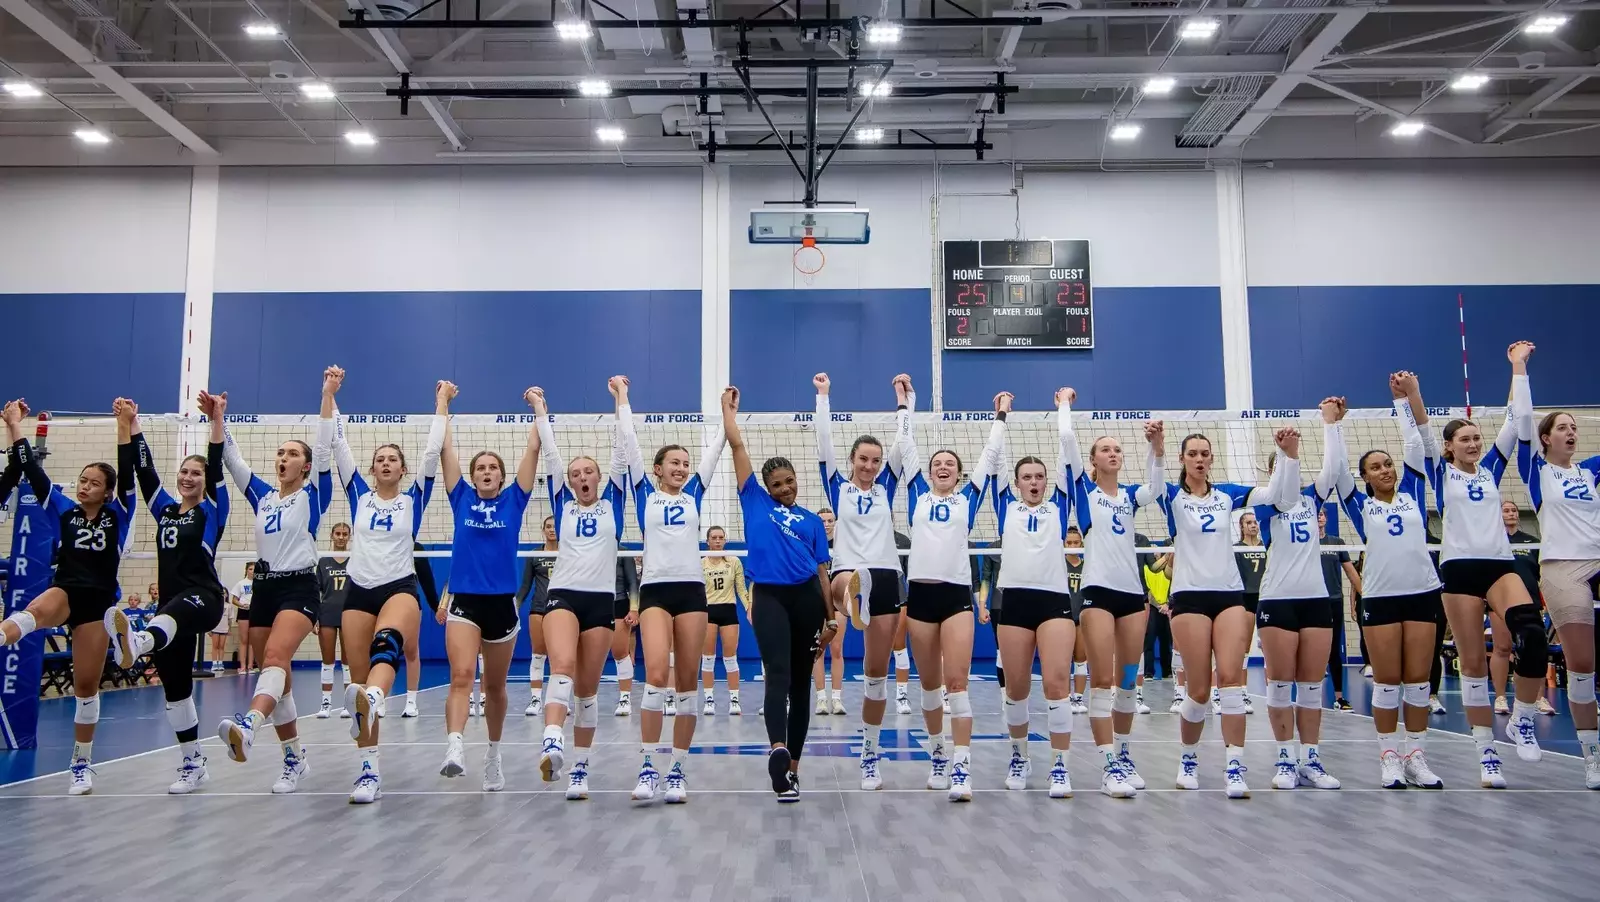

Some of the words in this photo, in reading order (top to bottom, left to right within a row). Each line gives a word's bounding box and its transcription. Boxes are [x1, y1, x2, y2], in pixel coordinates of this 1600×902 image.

[953, 269, 983, 280] HOME
[1004, 275, 1031, 283] PERIOD
[1050, 269, 1084, 280] GUEST
[958, 283, 986, 305] 25
[1013, 287, 1023, 302] 4
[1057, 283, 1085, 305] 23
[947, 308, 971, 316] FOULS
[993, 308, 1021, 316] PLAYER
[1025, 308, 1043, 316] FOUL
[1066, 307, 1089, 315] FOULS
[957, 317, 967, 335] 2
[1081, 318, 1086, 333] 1
[948, 338, 972, 346] SCORE
[1006, 338, 1032, 346] MATCH
[1066, 337, 1090, 346] SCORE
[794, 413, 813, 422] AIR
[831, 413, 852, 422] RCE
[943, 412, 962, 421] AIR
[966, 412, 995, 421] FORC
[1092, 411, 1111, 420] AIR
[1115, 411, 1151, 420] FORCE
[1241, 410, 1261, 419] AIR
[1265, 409, 1300, 418] FORCE
[1425, 407, 1450, 416] RCE
[223, 414, 258, 423] FORCE
[347, 415, 367, 423] AIR
[371, 415, 407, 423] FORCE
[496, 415, 515, 423] AIR
[520, 415, 555, 423] FOE
[645, 414, 666, 423] AIR
[669, 414, 704, 423] FORCE
[1563, 480, 1593, 501] 22
[857, 495, 873, 515] 17
[1197, 502, 1227, 514] FORCE
[1369, 506, 1383, 516] AIR
[664, 505, 685, 526] 12
[929, 504, 950, 522] 10
[264, 511, 282, 534] 21
[369, 512, 393, 531] 14
[576, 517, 597, 537] 18
[1027, 514, 1038, 532] 11
[1200, 514, 1216, 533] 2
[1387, 514, 1404, 537] 3
[161, 526, 178, 549] 13
[1289, 522, 1310, 543] 15
[14, 515, 31, 576] AIR
[74, 528, 106, 551] 23
[1251, 560, 1260, 573] 7
[333, 577, 346, 591] 17
[713, 578, 724, 591] 12
[1070, 579, 1078, 593] 4
[3, 589, 25, 694] FCE
